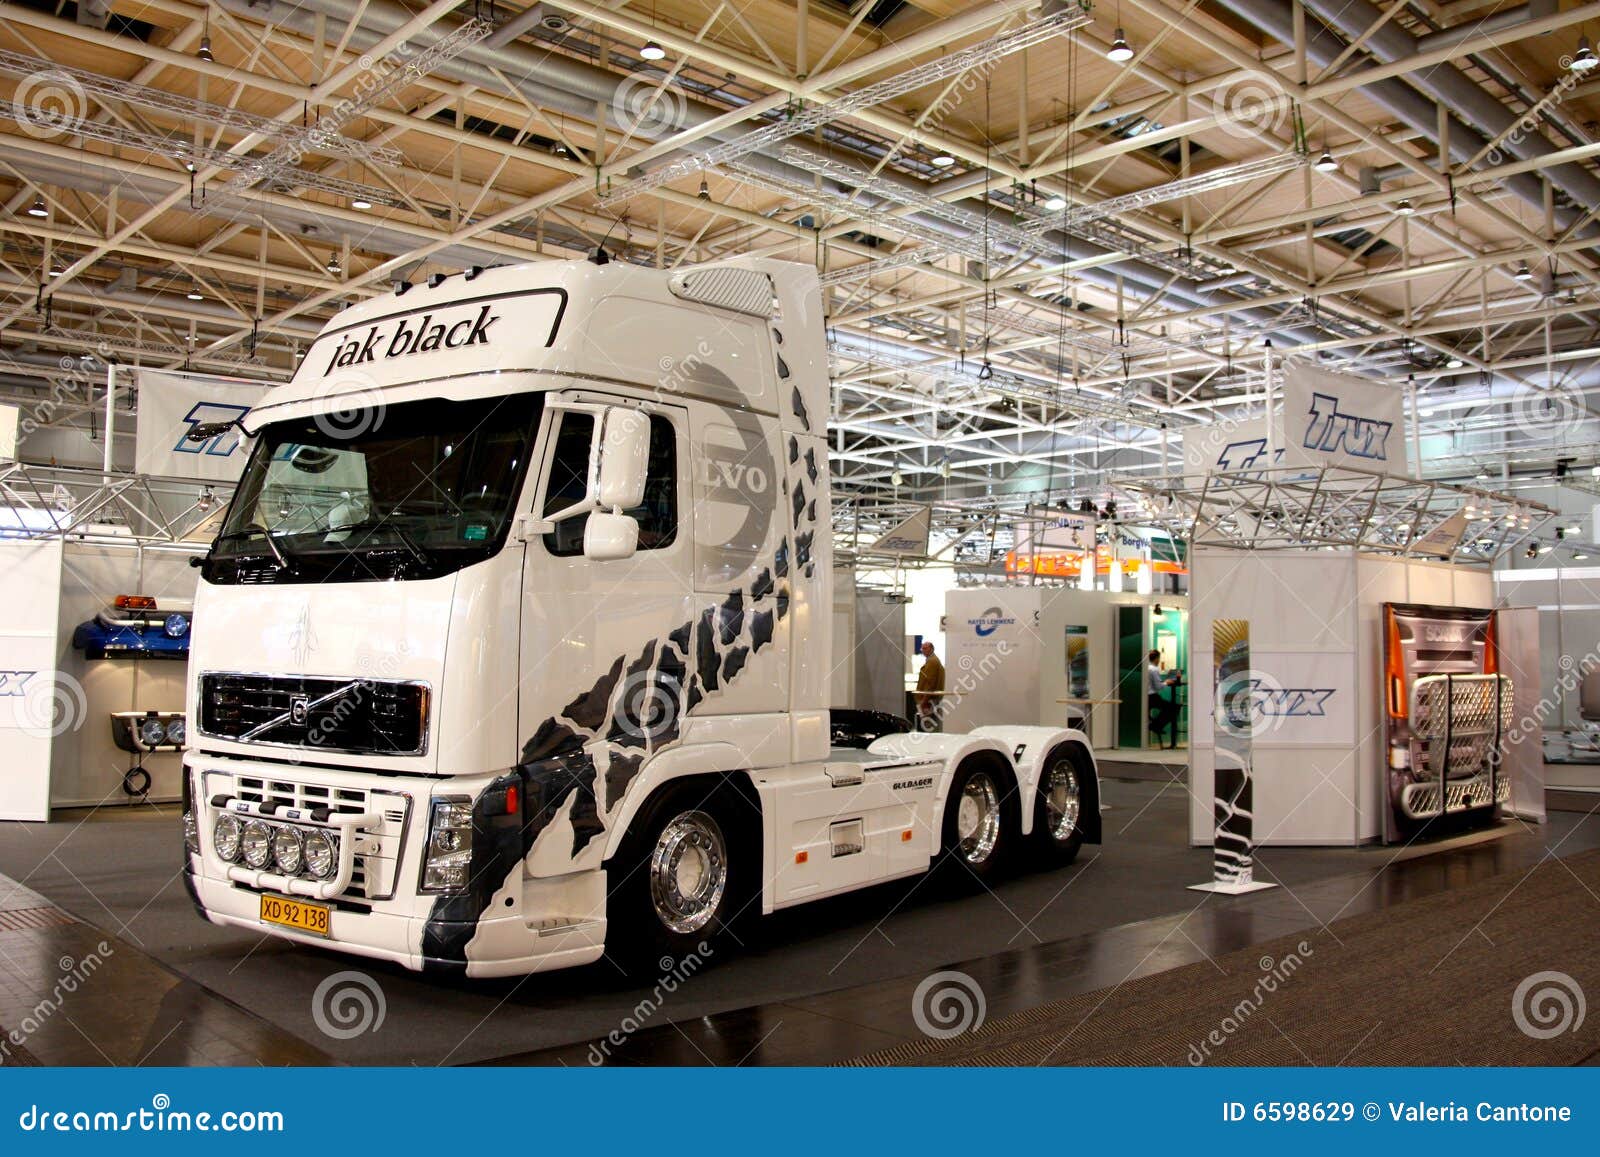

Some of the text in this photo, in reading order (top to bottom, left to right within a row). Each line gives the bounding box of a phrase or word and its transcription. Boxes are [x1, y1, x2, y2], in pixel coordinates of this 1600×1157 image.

[323, 305, 501, 377] jak black
[893, 778, 932, 790] GULDAGER
[264, 899, 326, 929] XD 92 138
